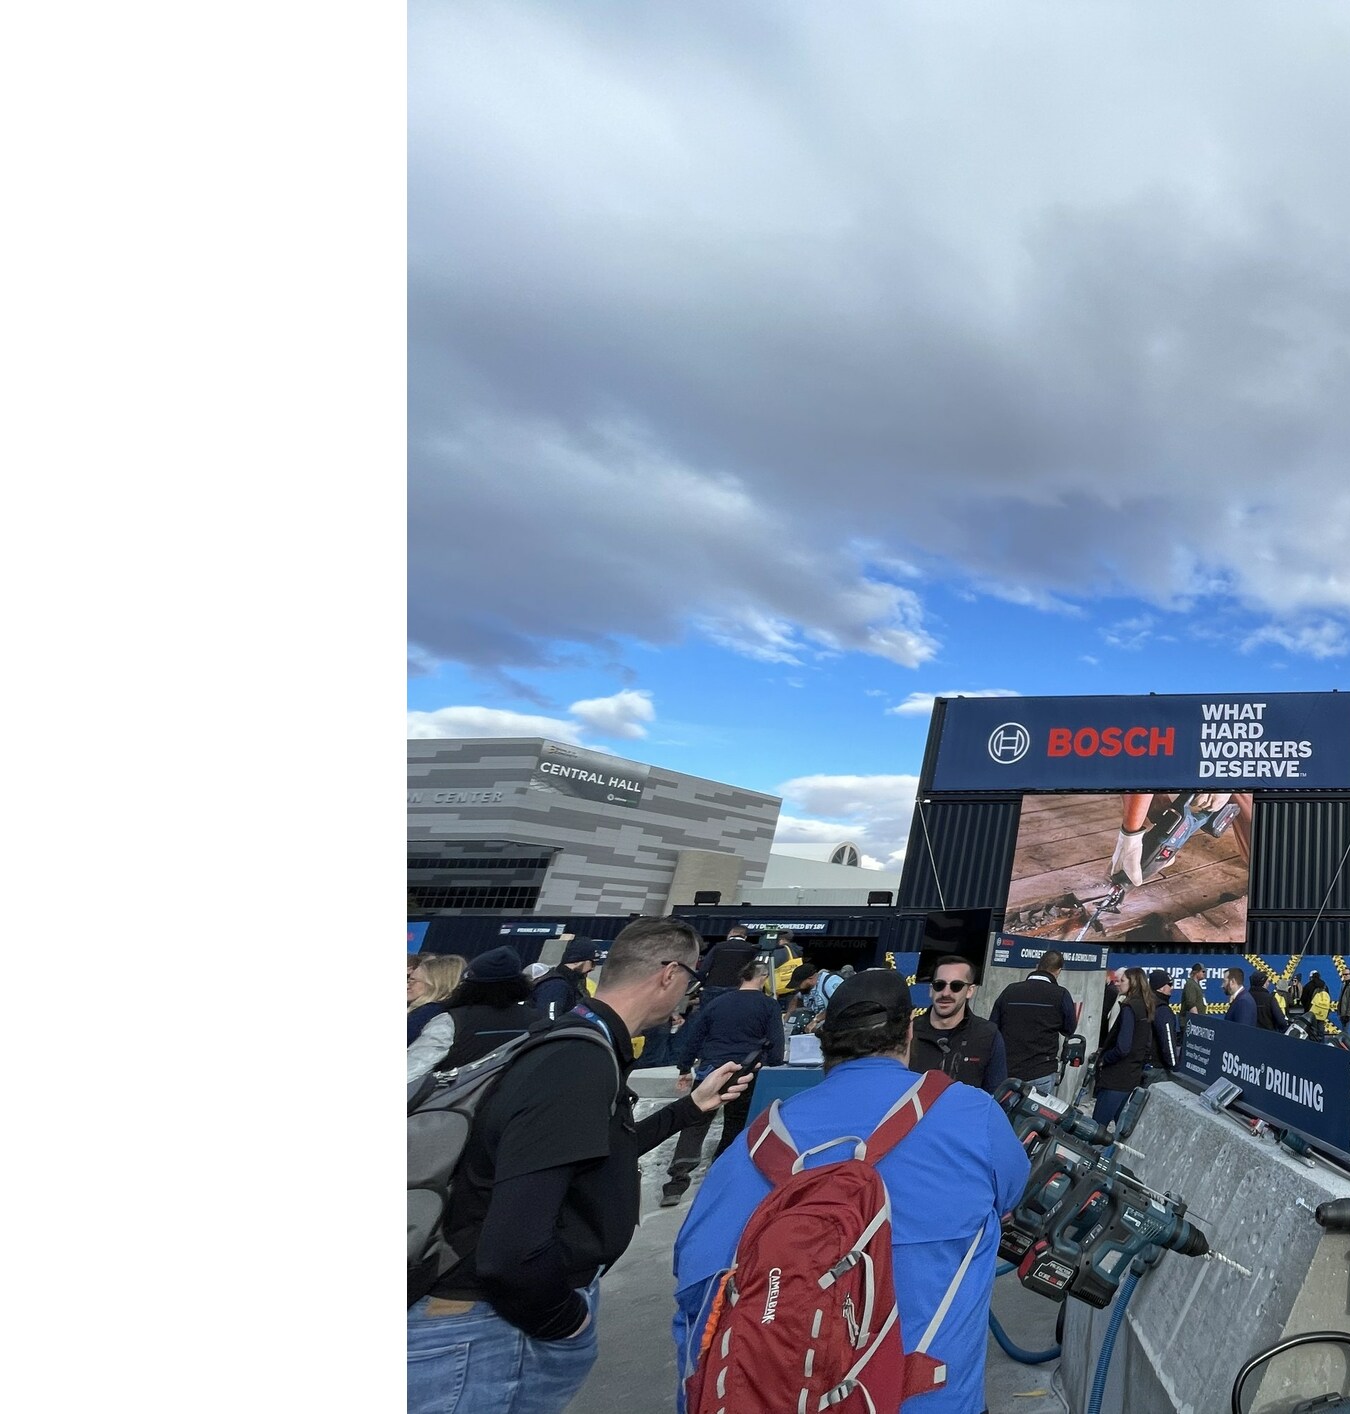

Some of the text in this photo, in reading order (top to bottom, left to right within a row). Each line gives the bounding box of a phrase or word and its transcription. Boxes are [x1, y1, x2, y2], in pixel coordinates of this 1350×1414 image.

[1202, 703, 1266, 720] WHAT
[1047, 726, 1175, 757] BOSCH
[1201, 723, 1264, 740] HARD
[1200, 741, 1312, 758] WORKERS
[540, 762, 642, 793] CENTRAL HALL
[434, 791, 503, 804] CENTER
[1265, 1066, 1324, 1112] DRILLING
[761, 1267, 782, 1324] CAMELBAK
